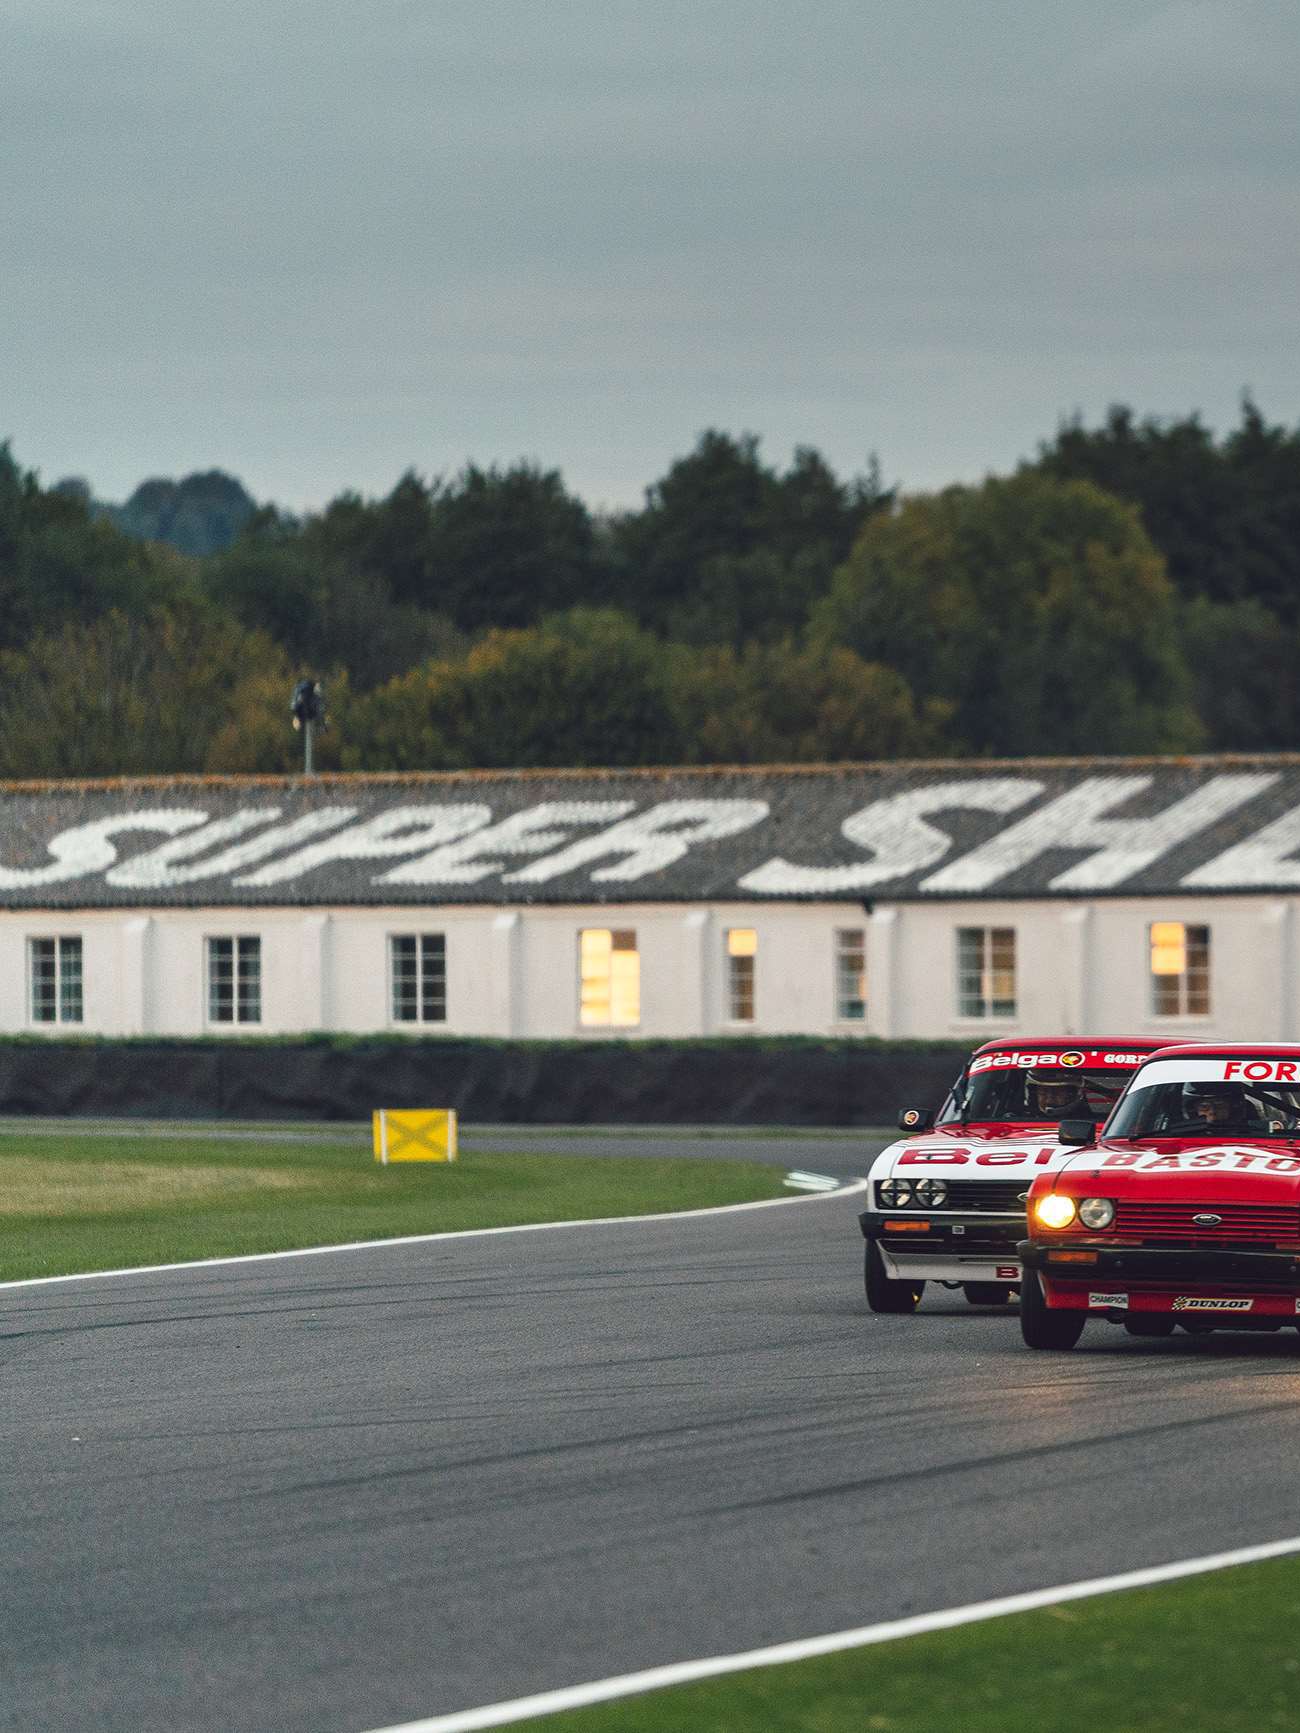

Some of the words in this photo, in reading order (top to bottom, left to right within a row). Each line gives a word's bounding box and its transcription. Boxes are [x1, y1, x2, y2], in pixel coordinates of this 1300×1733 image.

[0, 799, 769, 889] SUPER
[969, 1053, 1057, 1074] Belga
[897, 1147, 1056, 1166] Bel
[1090, 1294, 1128, 1305] CHAMPION
[1187, 1298, 1250, 1309] DUNLOP
